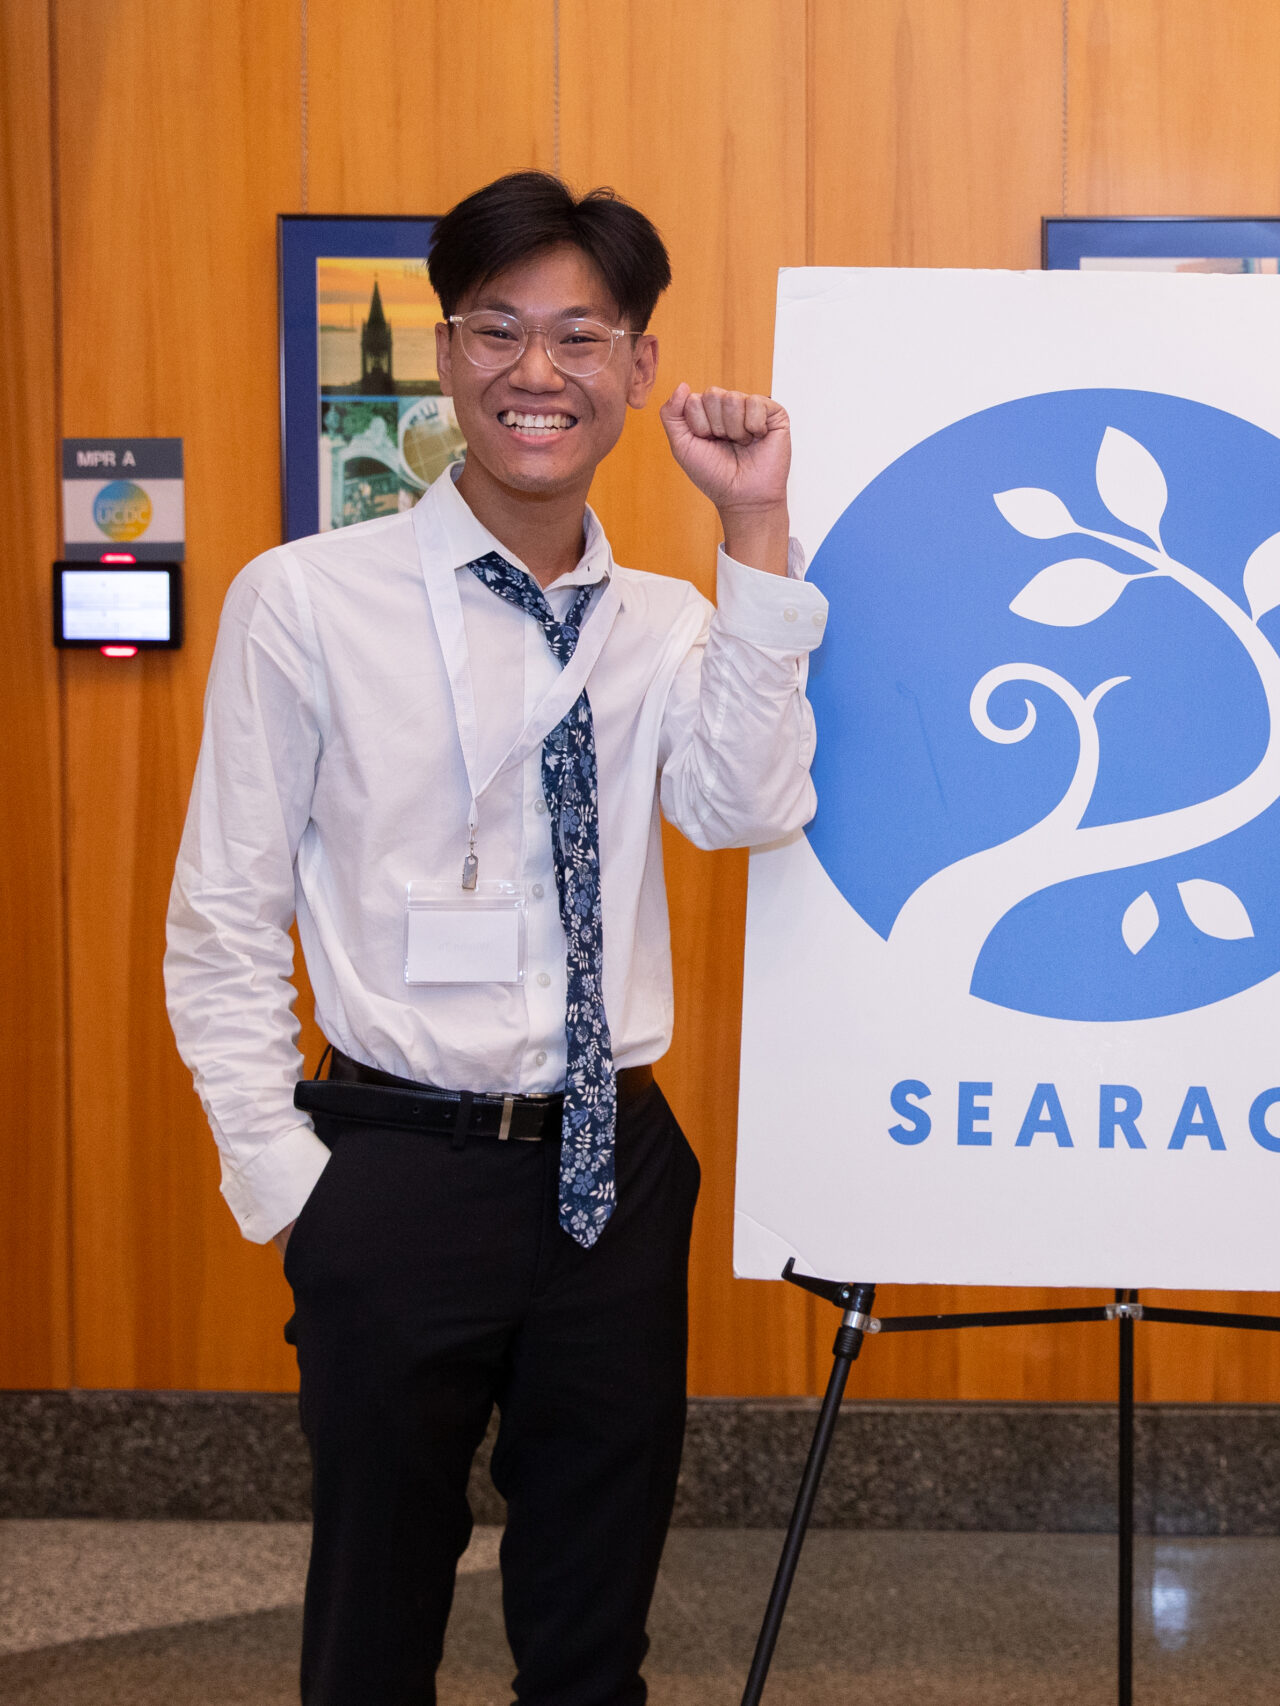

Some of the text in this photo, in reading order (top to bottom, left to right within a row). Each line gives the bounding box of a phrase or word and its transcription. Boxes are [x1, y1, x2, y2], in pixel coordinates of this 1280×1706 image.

[76, 450, 136, 467] MPR A
[96, 506, 150, 525] UCDC
